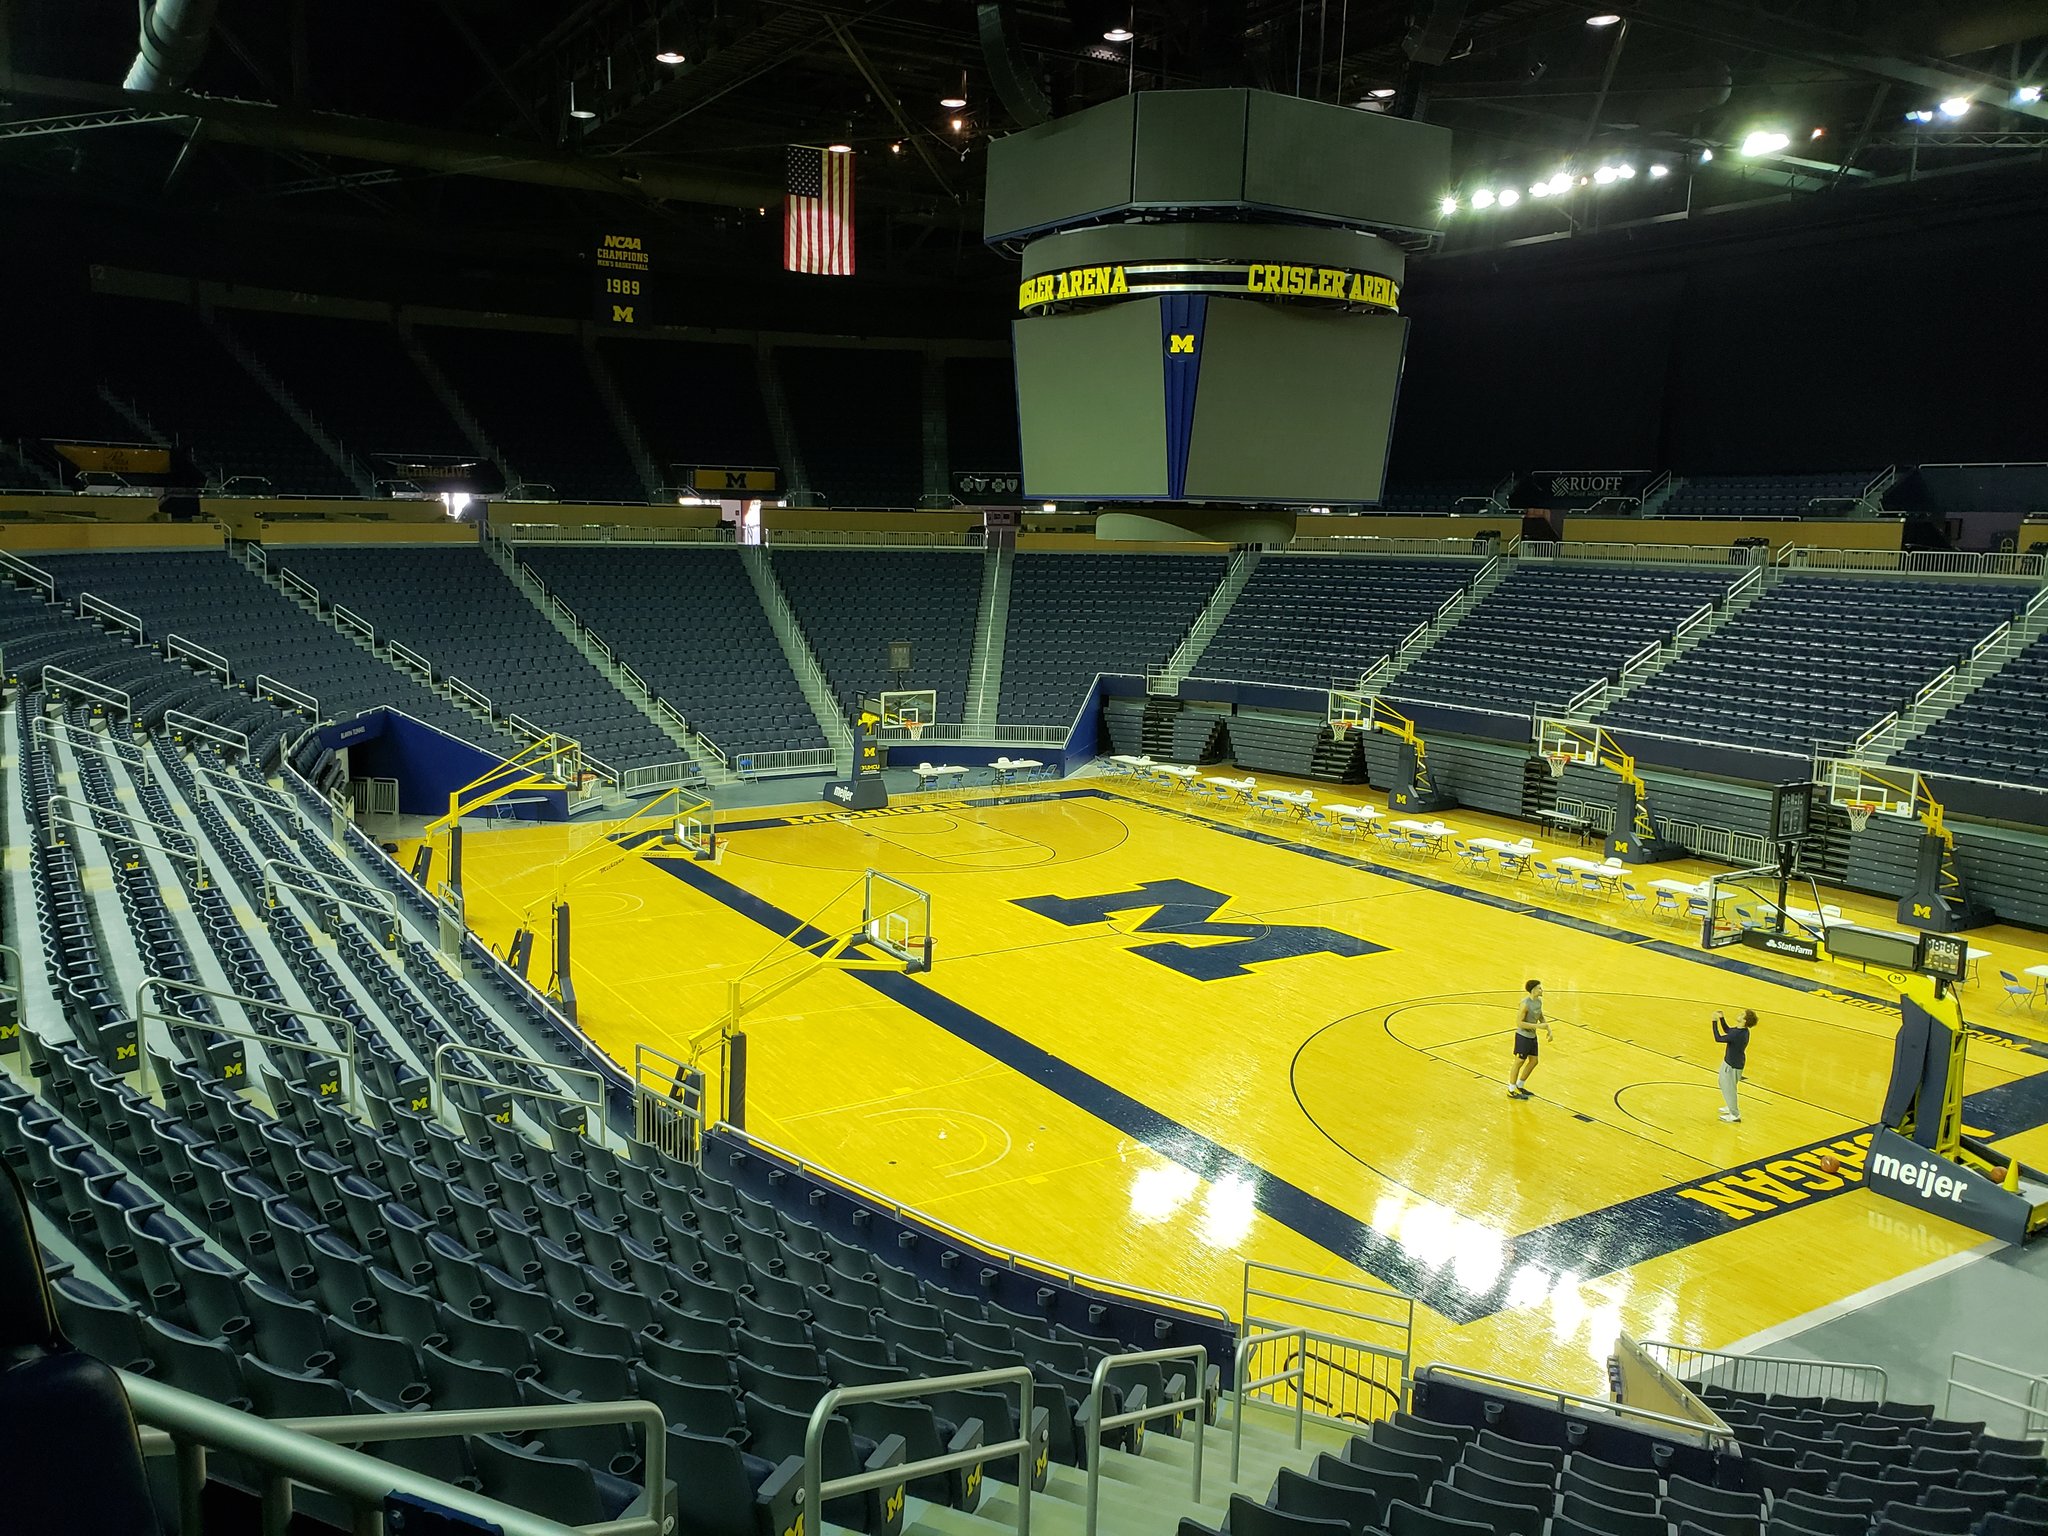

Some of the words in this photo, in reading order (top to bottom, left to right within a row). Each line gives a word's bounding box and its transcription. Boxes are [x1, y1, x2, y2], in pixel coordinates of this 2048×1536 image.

[604, 235, 641, 250] NCAA
[597, 248, 648, 262] CHAMPIONS
[607, 278, 640, 295] 1989
[1057, 266, 1128, 299] ARENA
[1248, 264, 1346, 298] CRISLER
[1349, 273, 1397, 307] ARENA
[613, 305, 634, 323] M
[1171, 335, 1194, 353] M
[726, 473, 747, 489] M
[1570, 476, 1622, 491] RUOFF
[864, 747, 875, 757] M
[834, 785, 853, 801] meijer
[780, 800, 974, 826] MICHIGAN
[1614, 840, 1628, 853] M
[1913, 903, 1932, 919] M
[1872, 1152, 1968, 1204] meijer
